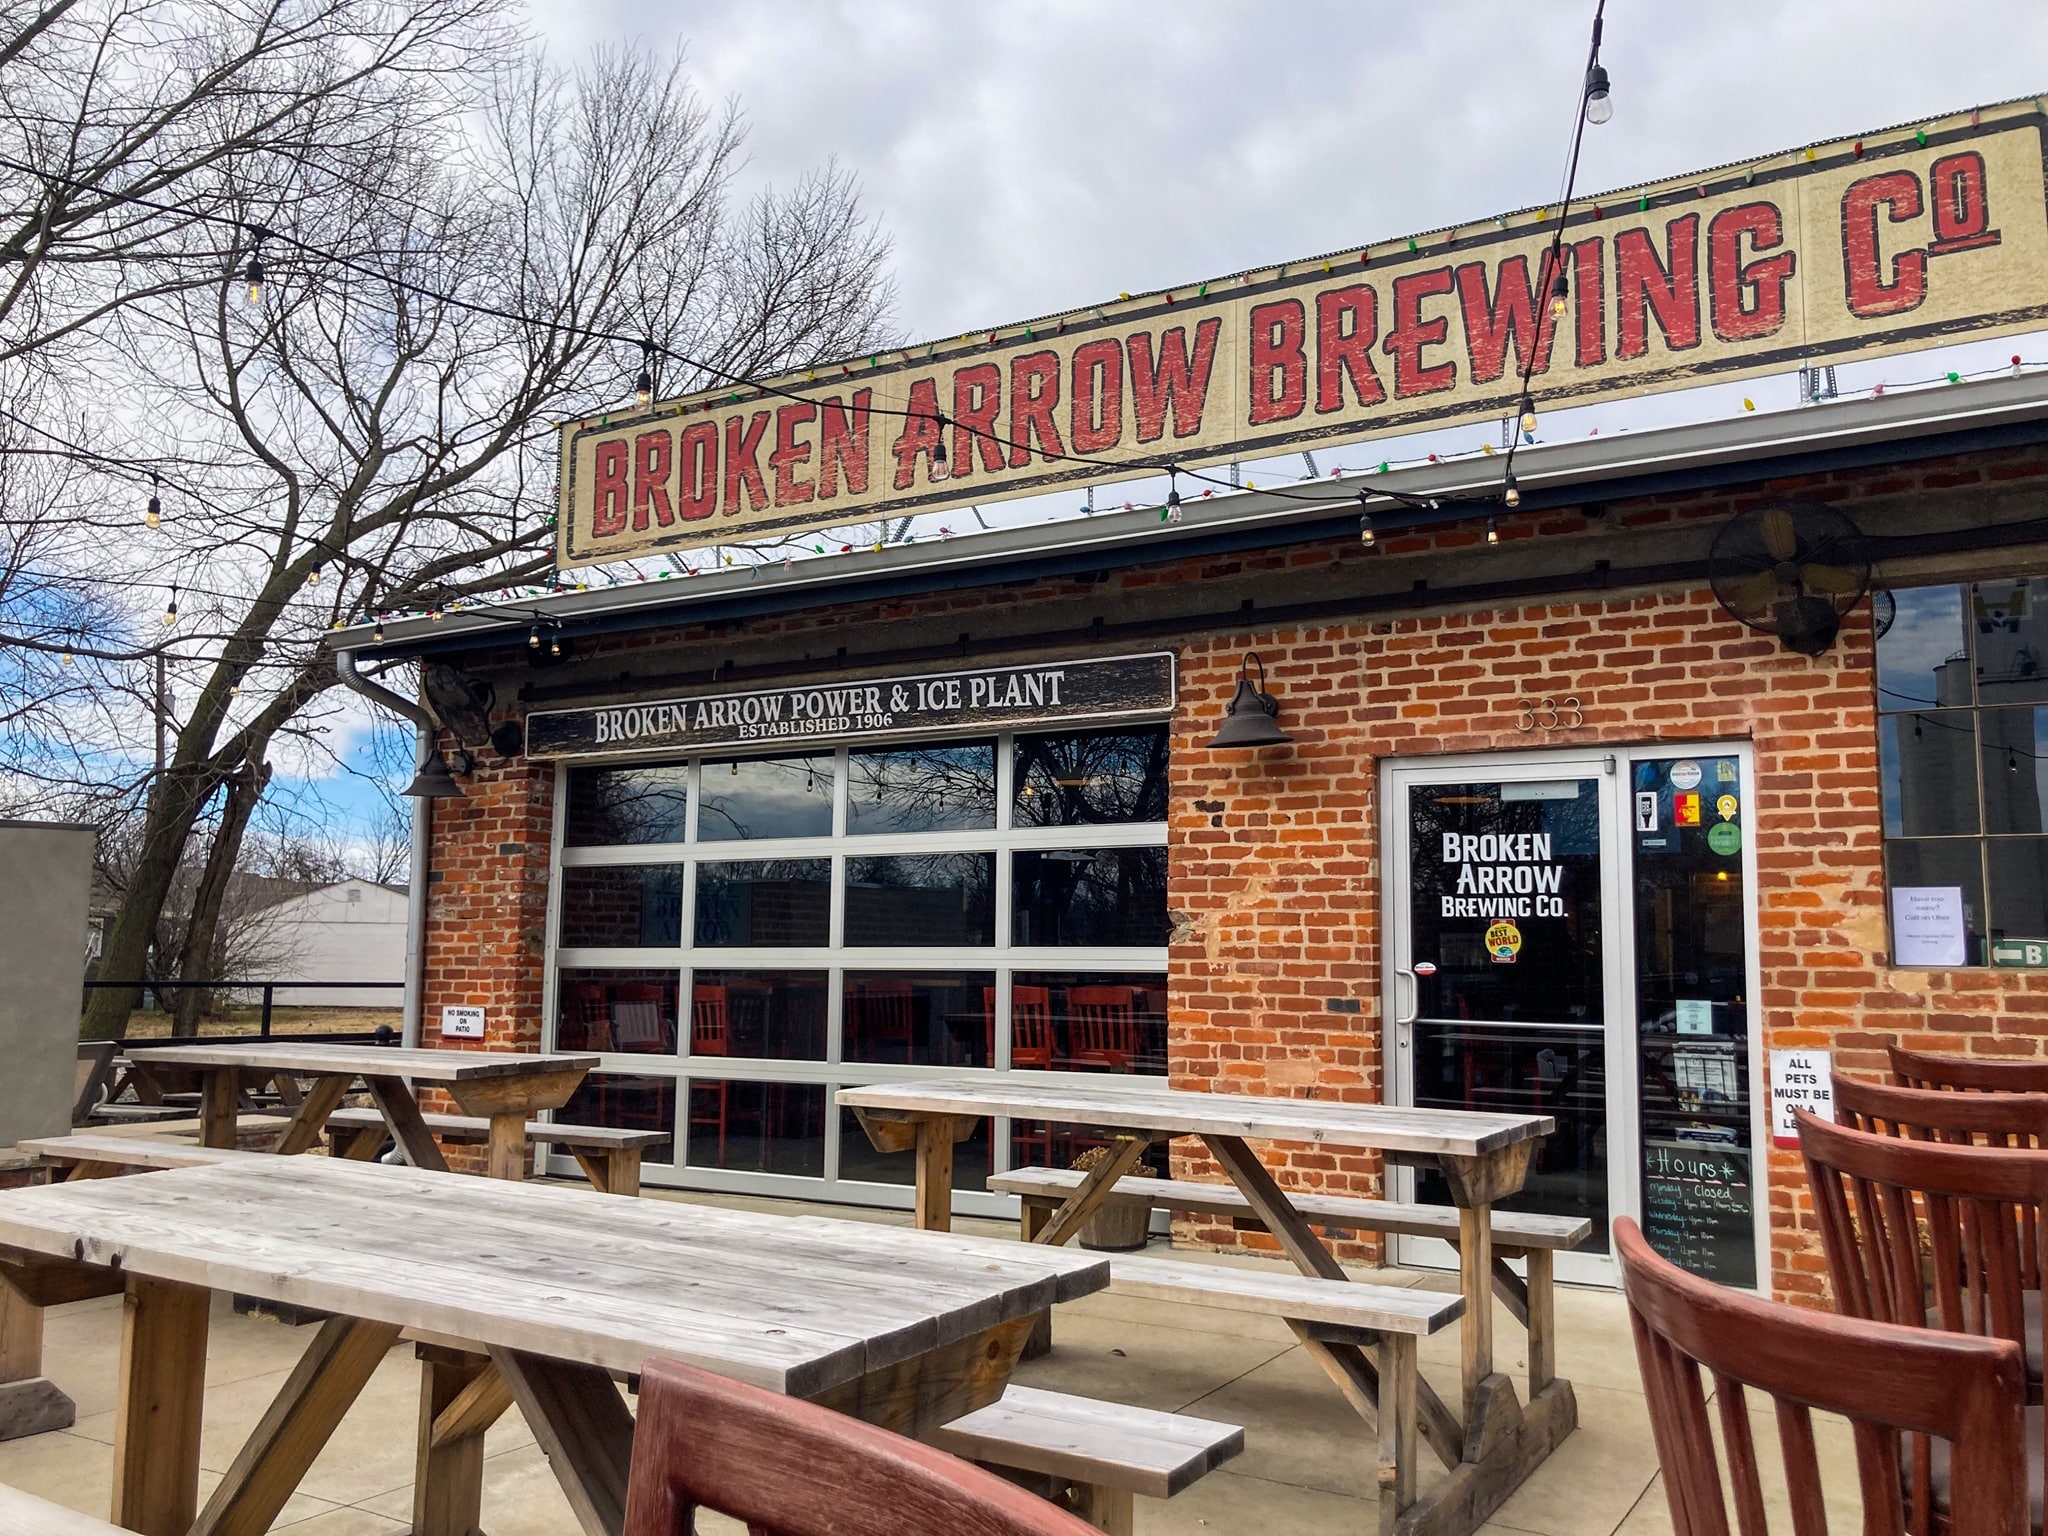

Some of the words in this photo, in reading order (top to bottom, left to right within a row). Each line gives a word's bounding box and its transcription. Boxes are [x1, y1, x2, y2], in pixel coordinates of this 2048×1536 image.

[592, 387, 872, 538] BROKEN
[893, 316, 1223, 492] ARROW
[1249, 200, 1797, 427] BREWING
[595, 704, 688, 744] BROKEN
[693, 695, 784, 730] ARROW
[791, 686, 883, 719] POWER
[890, 684, 910, 713] &
[917, 679, 962, 711] ICE
[969, 671, 1065, 709] PLANT
[1515, 697, 1583, 731] 333
[739, 716, 850, 738] ESTABLISHED
[855, 712, 893, 730] 1906
[1443, 832, 1551, 863] BROKEN
[1457, 864, 1563, 894] ARROW
[1488, 935, 1519, 947] WORLD
[1490, 929, 1508, 938] BEST
[2025, 945, 2048, 965] B
[1789, 1059, 1812, 1069] ALL
[1785, 1074, 1817, 1085] PETS
[1774, 1088, 1808, 1099] MUST
[1813, 1090, 1830, 1100] BE
[1808, 1105, 1816, 1114] A
[1694, 1185, 1733, 1200] Closed
